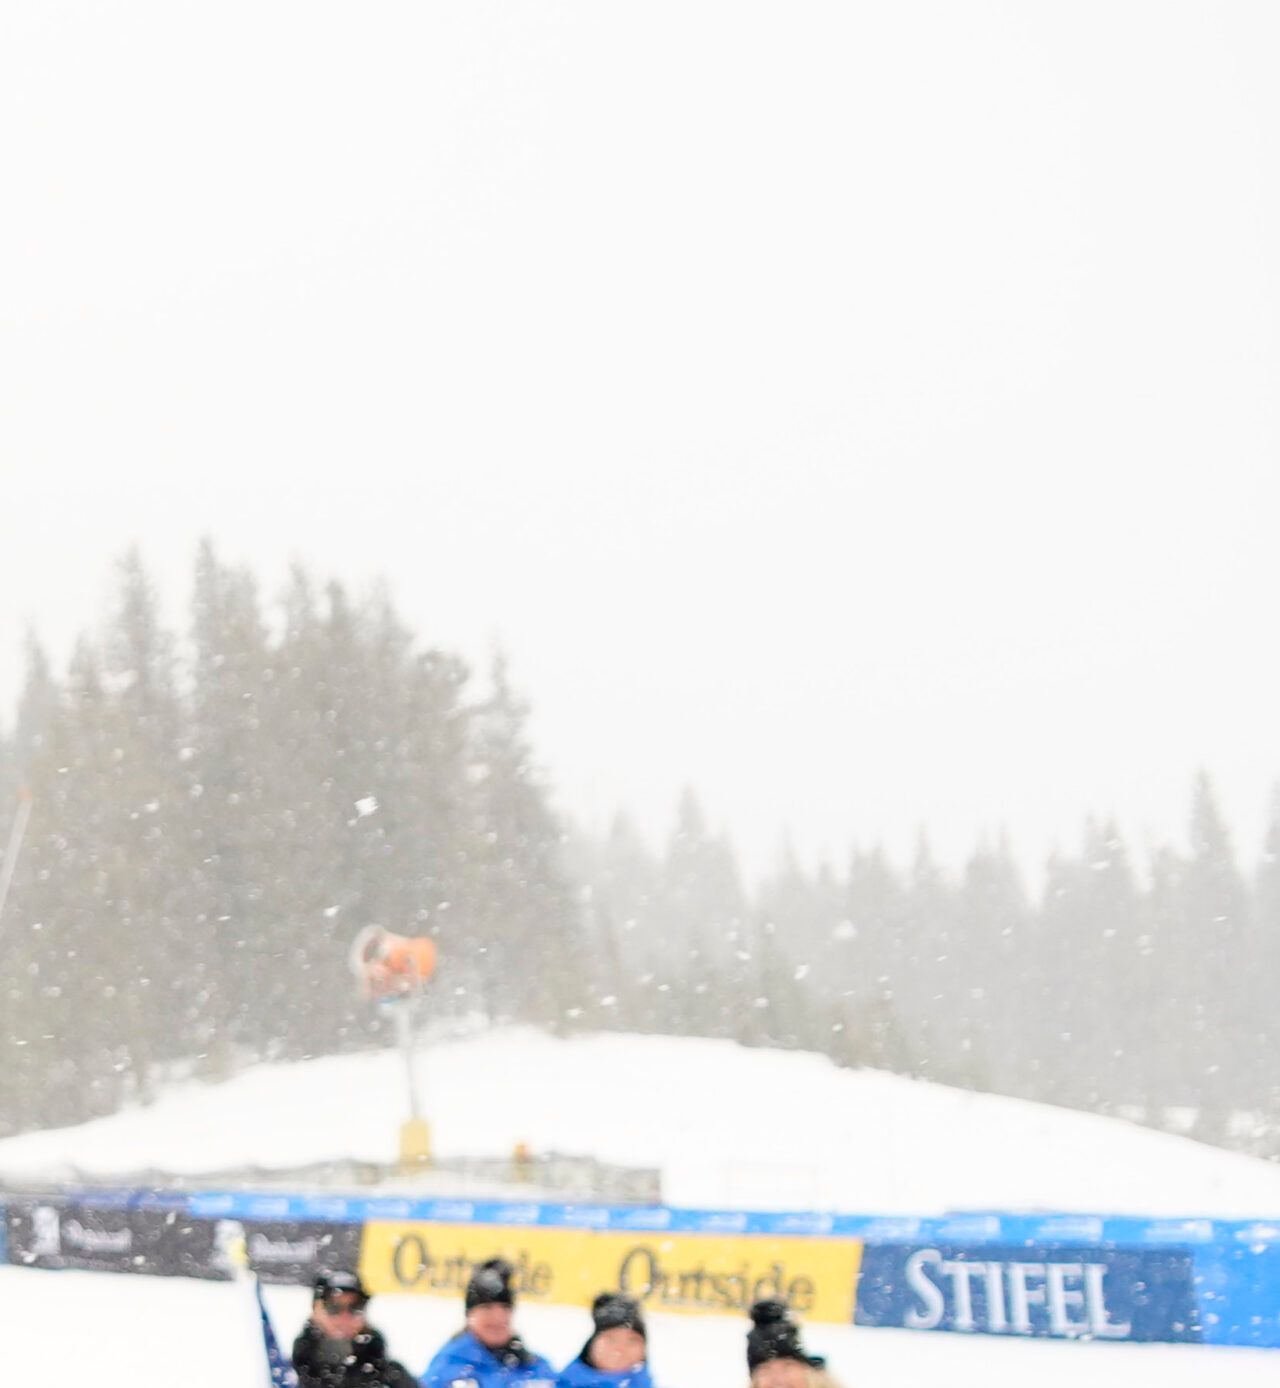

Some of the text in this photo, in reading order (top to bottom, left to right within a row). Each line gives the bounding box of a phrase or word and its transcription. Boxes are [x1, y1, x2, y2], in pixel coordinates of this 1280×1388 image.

[392, 1232, 554, 1297] Outde
[618, 1244, 815, 1312] Outside
[903, 1248, 1133, 1339] STIFEL
